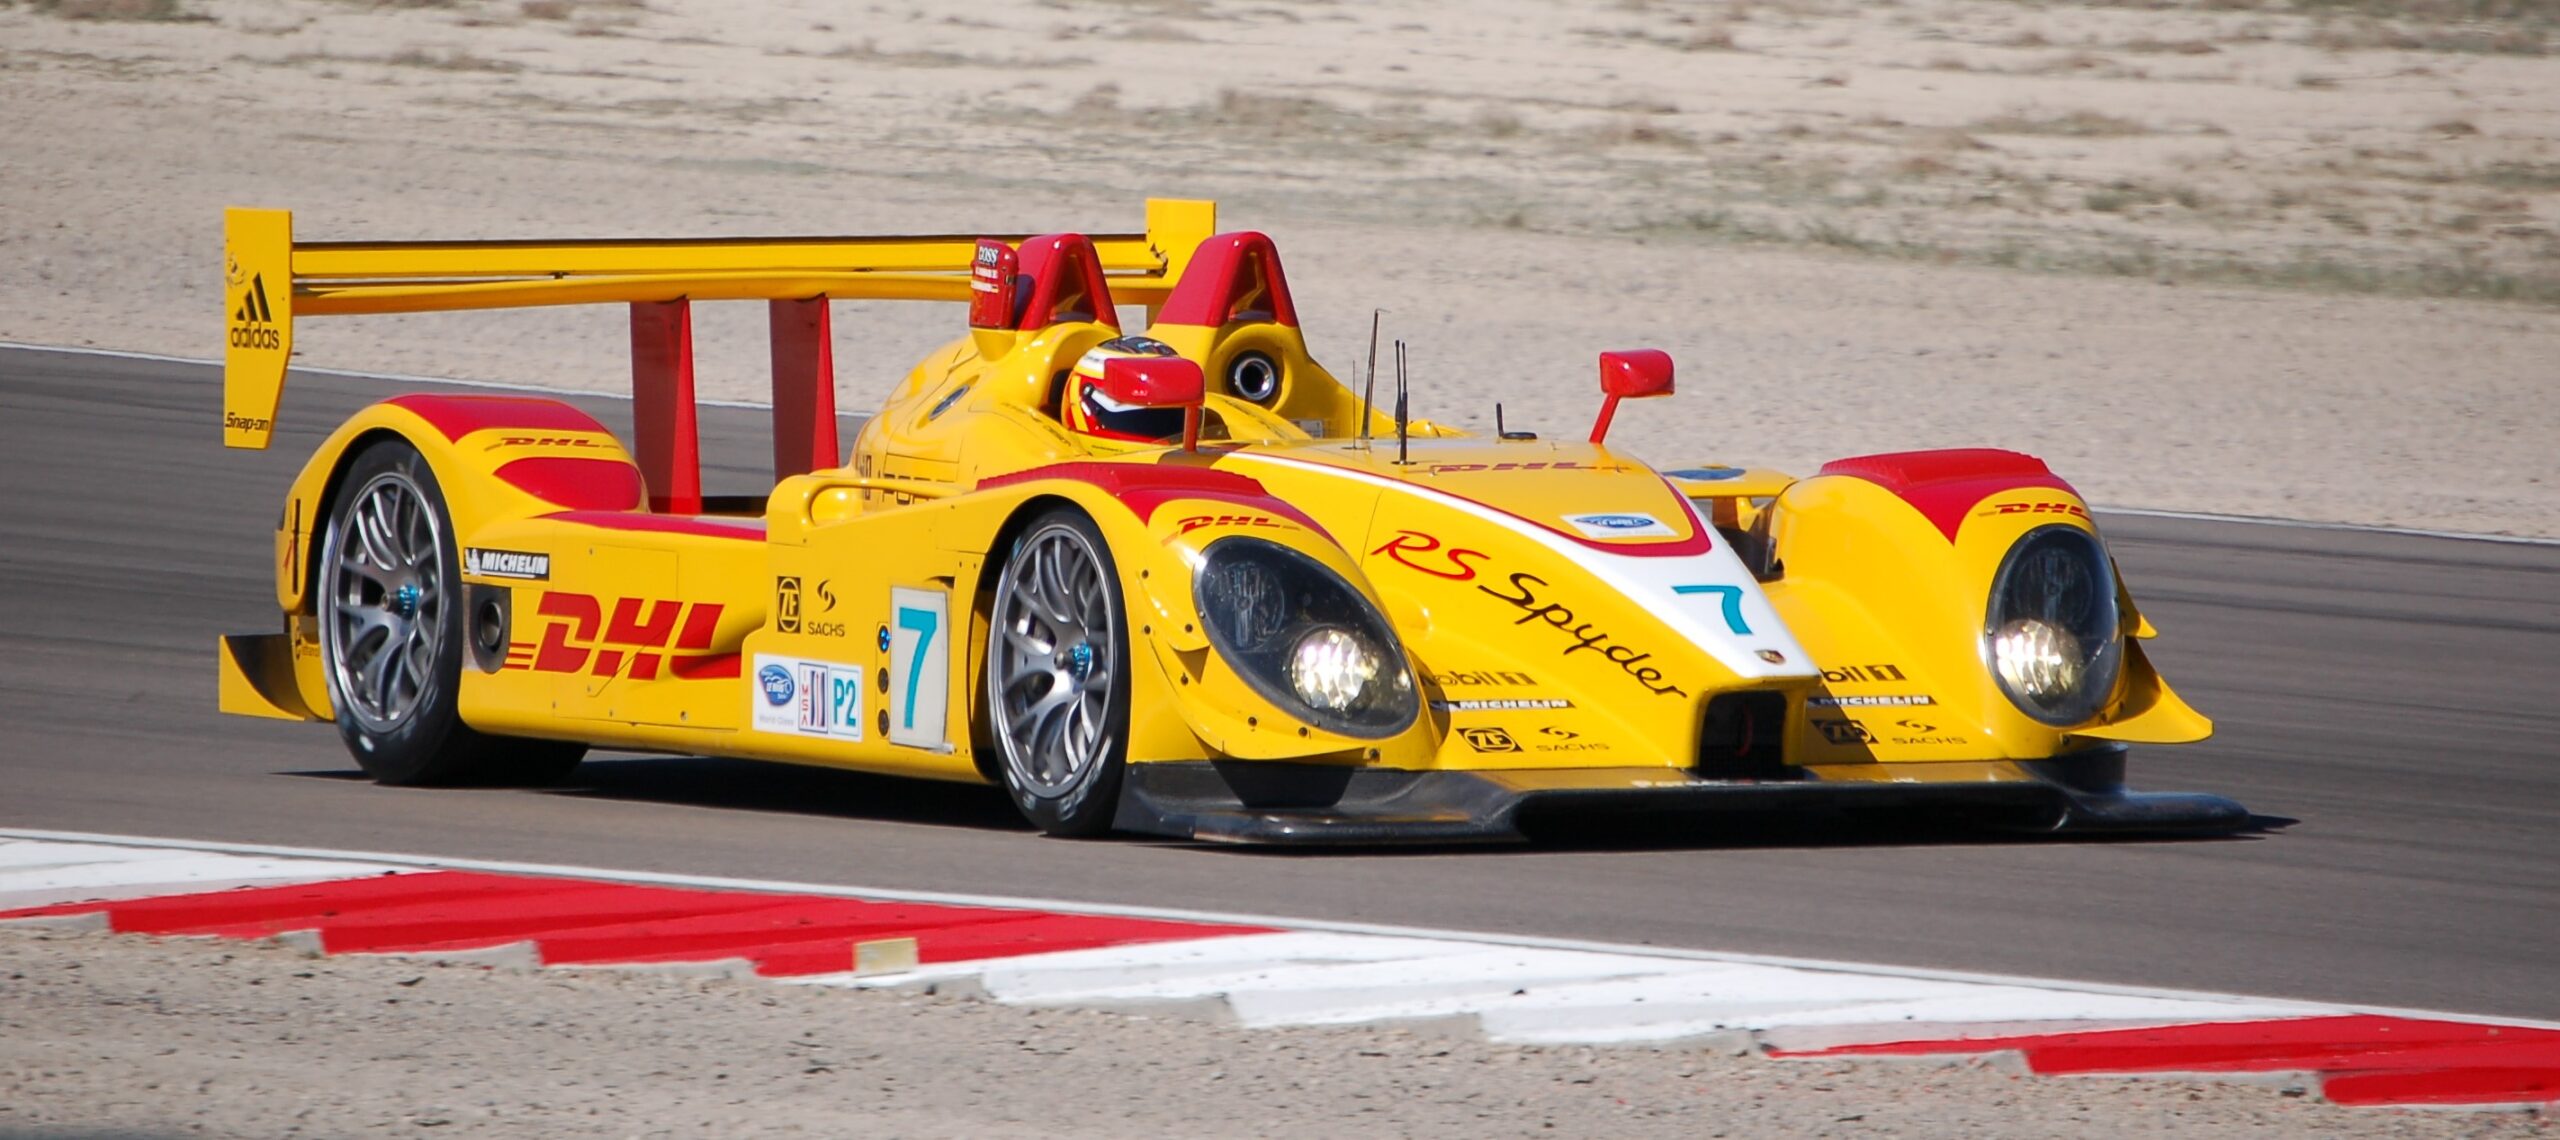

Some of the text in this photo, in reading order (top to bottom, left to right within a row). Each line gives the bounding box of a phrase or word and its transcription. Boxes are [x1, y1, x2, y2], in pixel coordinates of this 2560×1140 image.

[231, 321, 280, 350] adidas
[225, 412, 271, 433] Snap-on
[501, 437, 600, 446] DHL
[1430, 462, 1597, 472] DHL
[1995, 503, 2092, 522] DHL
[1177, 516, 1280, 535] DHL
[481, 552, 548, 575] MICHELIN
[1370, 530, 1688, 699] RS Spyder
[1670, 584, 1754, 636] 7
[533, 591, 742, 681] DHL
[807, 621, 845, 637] SACHS
[898, 607, 937, 730] 7
[833, 677, 857, 728] P2
[1459, 699, 1568, 709] MICHELIN
[1820, 695, 1930, 705] MICHELIN
[1536, 743, 1610, 751] SACHS
[1892, 736, 1968, 745] SACHS
